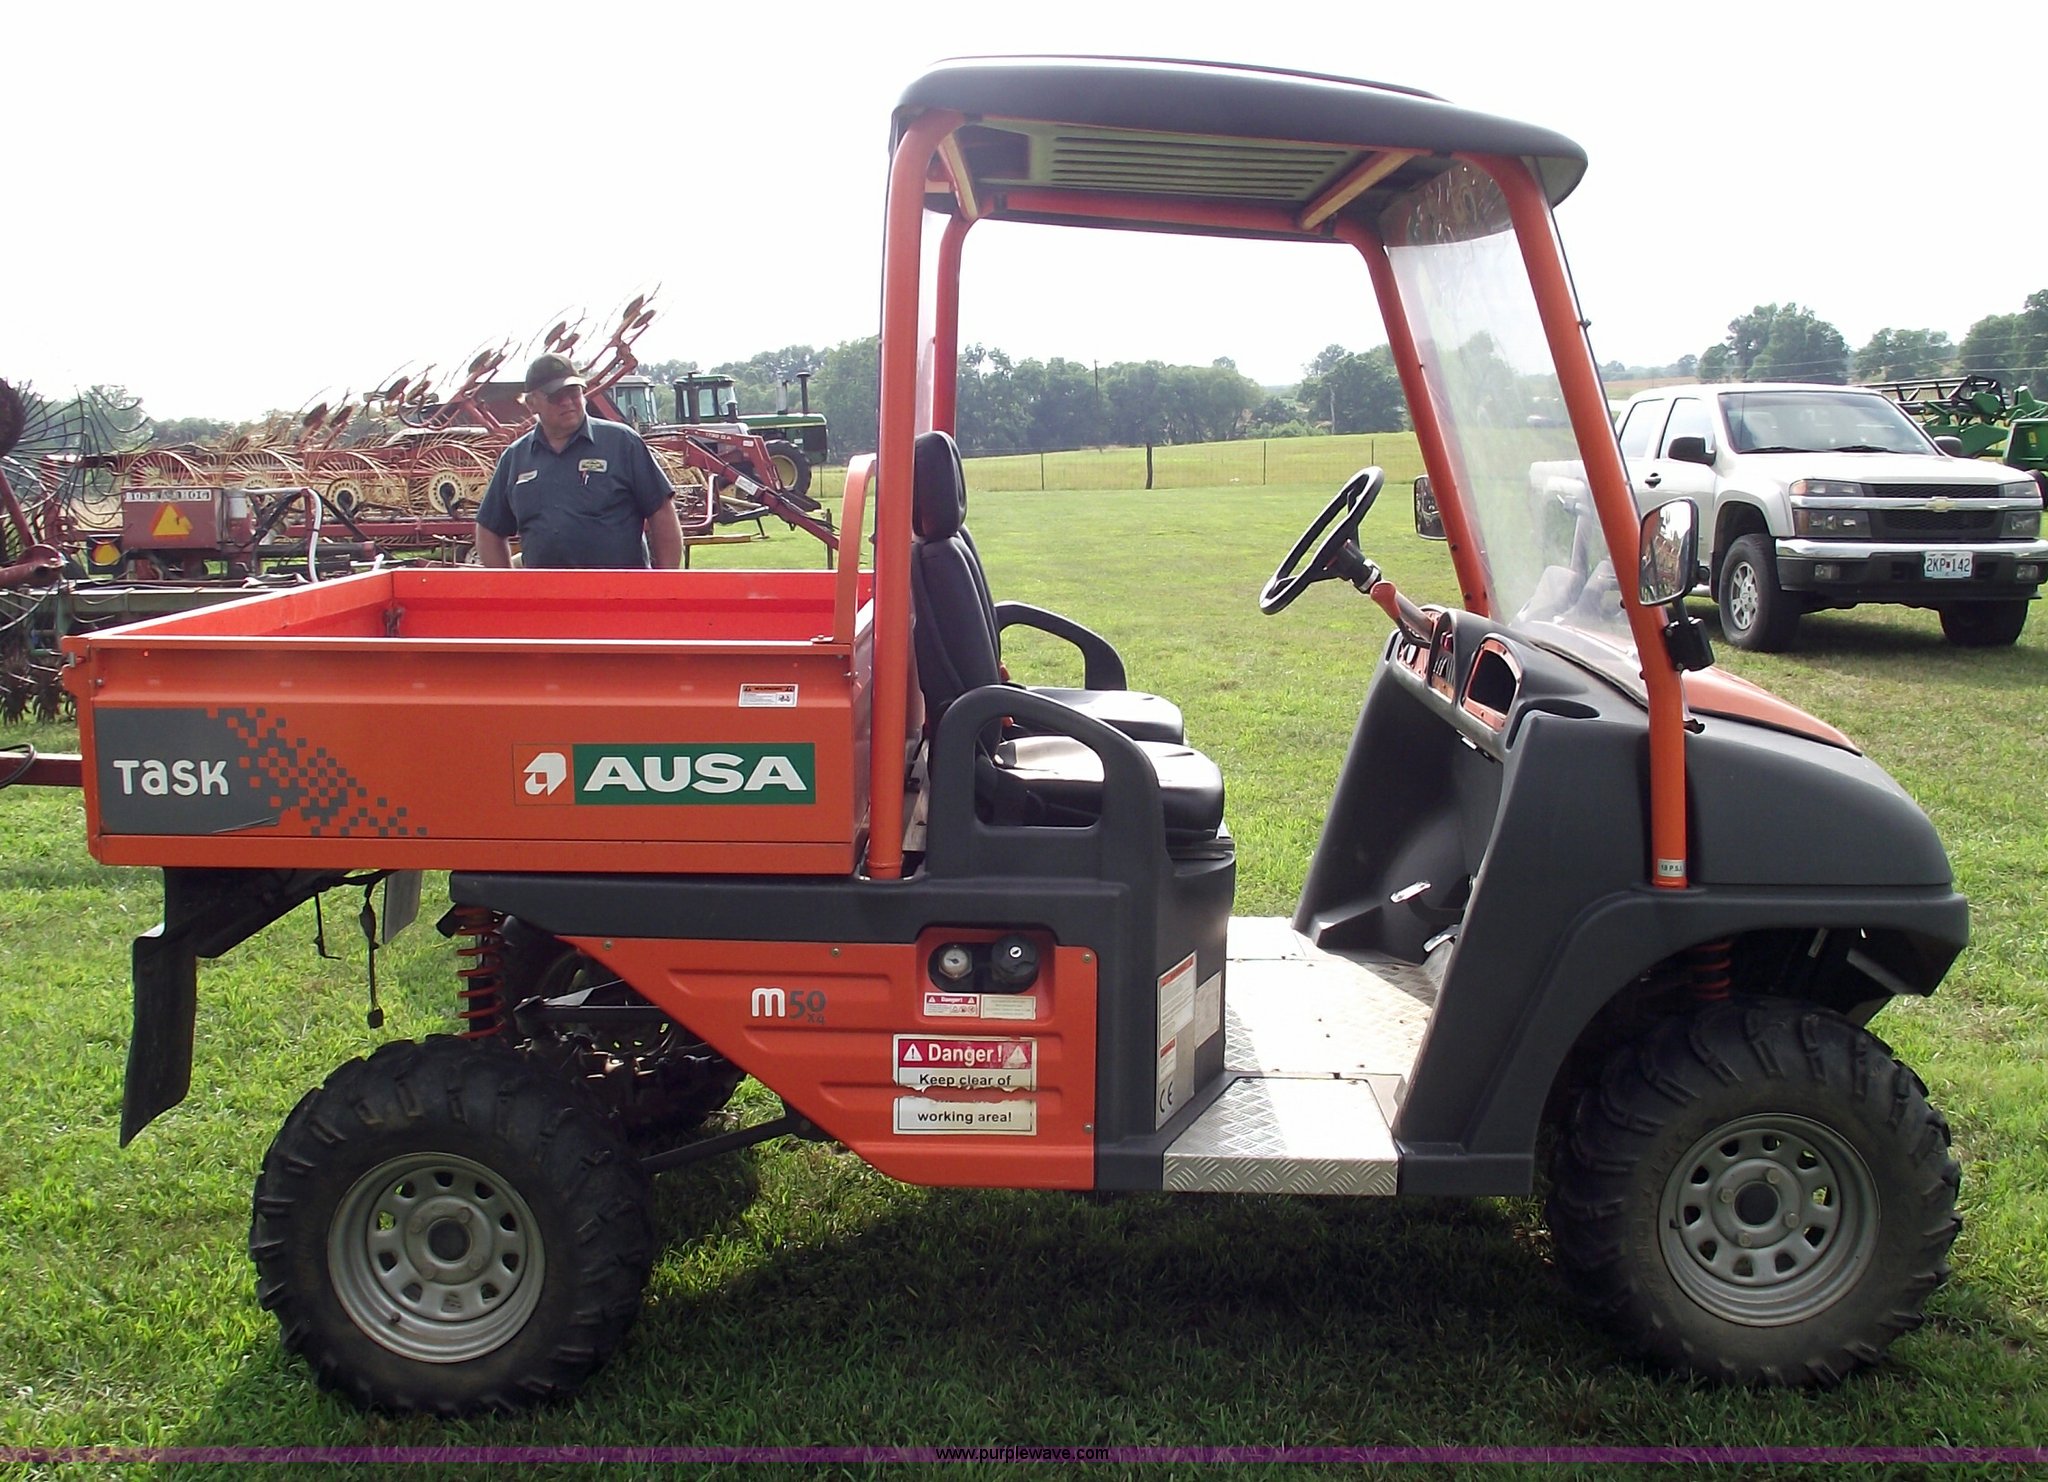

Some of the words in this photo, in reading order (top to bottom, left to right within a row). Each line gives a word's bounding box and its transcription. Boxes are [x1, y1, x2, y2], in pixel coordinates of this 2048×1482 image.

[1926, 557, 1946, 572] 2KP
[1952, 557, 1971, 572] 142
[583, 753, 808, 794] AUSA
[919, 1074, 955, 1087] Keep
[959, 1074, 993, 1086] clear
[997, 1075, 1012, 1086] of
[917, 1111, 974, 1125] working
[978, 1112, 1012, 1123] area!
